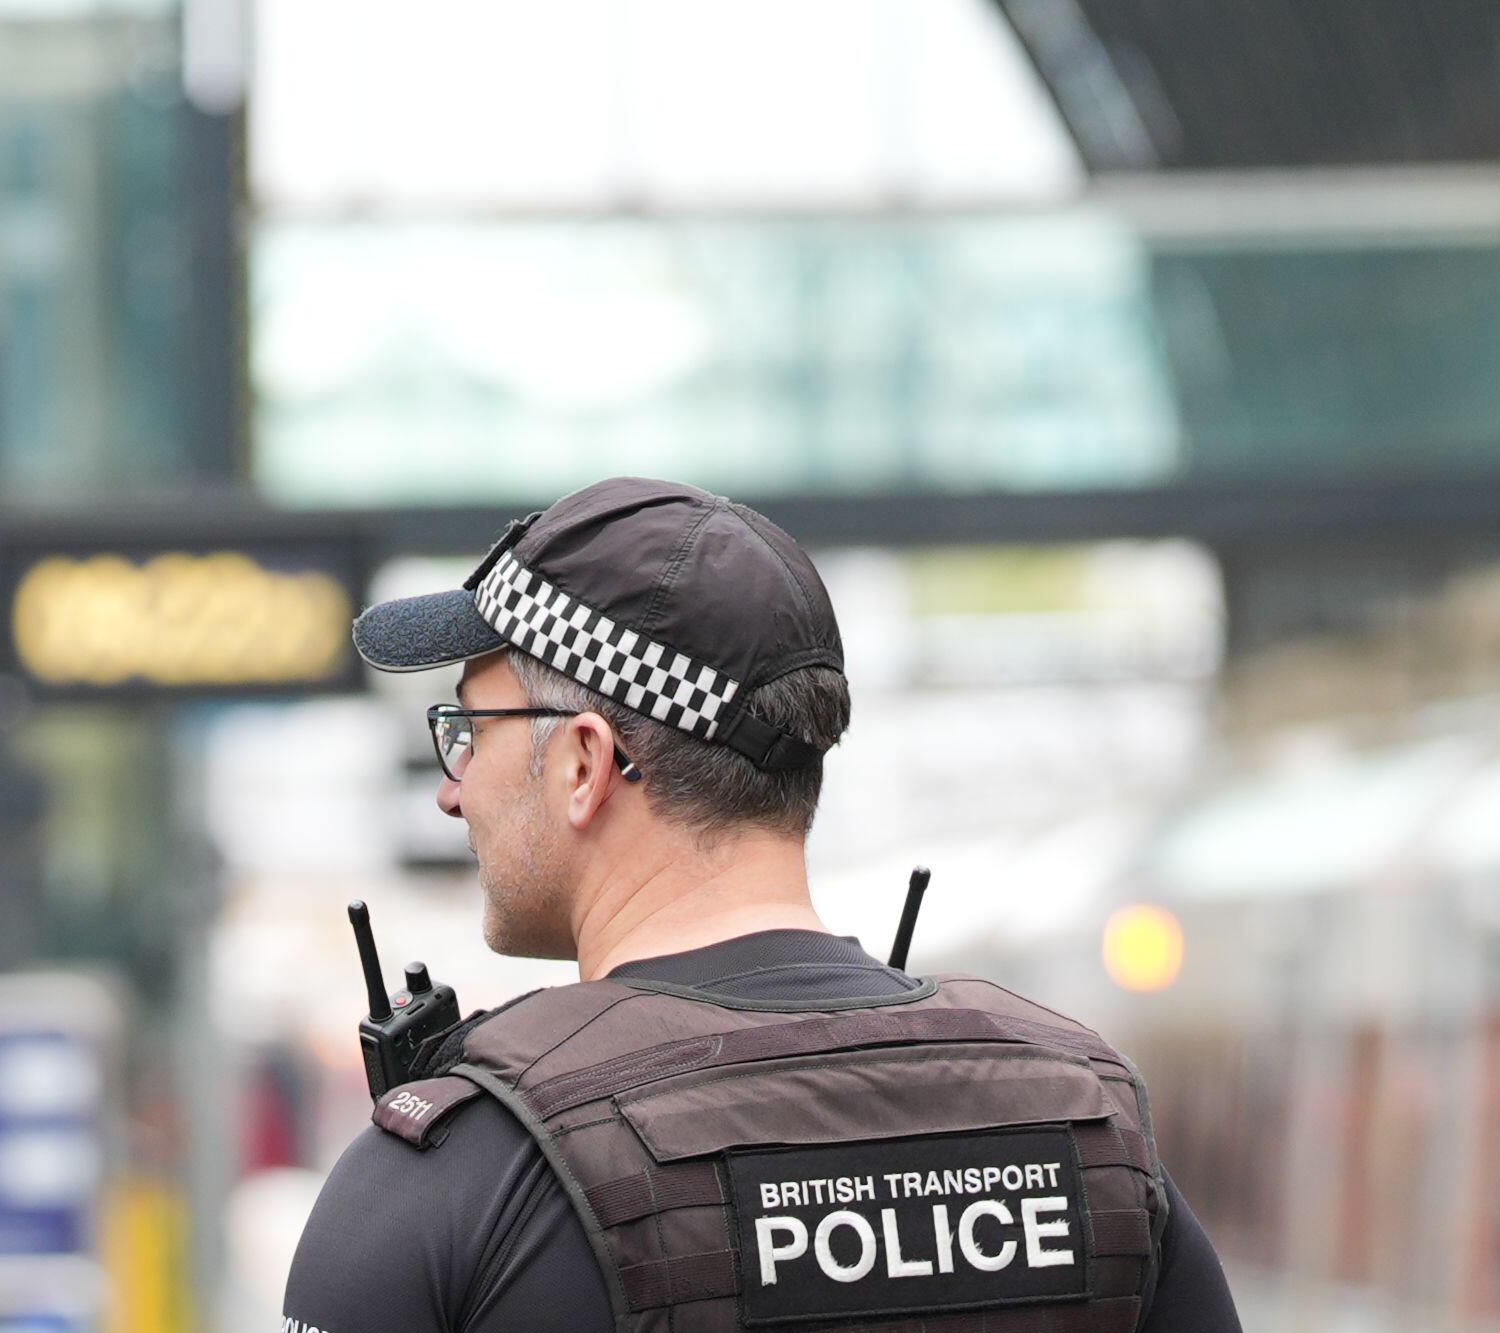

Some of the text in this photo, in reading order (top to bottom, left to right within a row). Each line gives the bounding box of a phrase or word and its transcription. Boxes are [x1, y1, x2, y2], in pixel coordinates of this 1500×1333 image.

[388, 1091, 433, 1121] 2511
[760, 1163, 1061, 1208] BRITISH TRANSPORT
[755, 1197, 1075, 1286] POLICE
